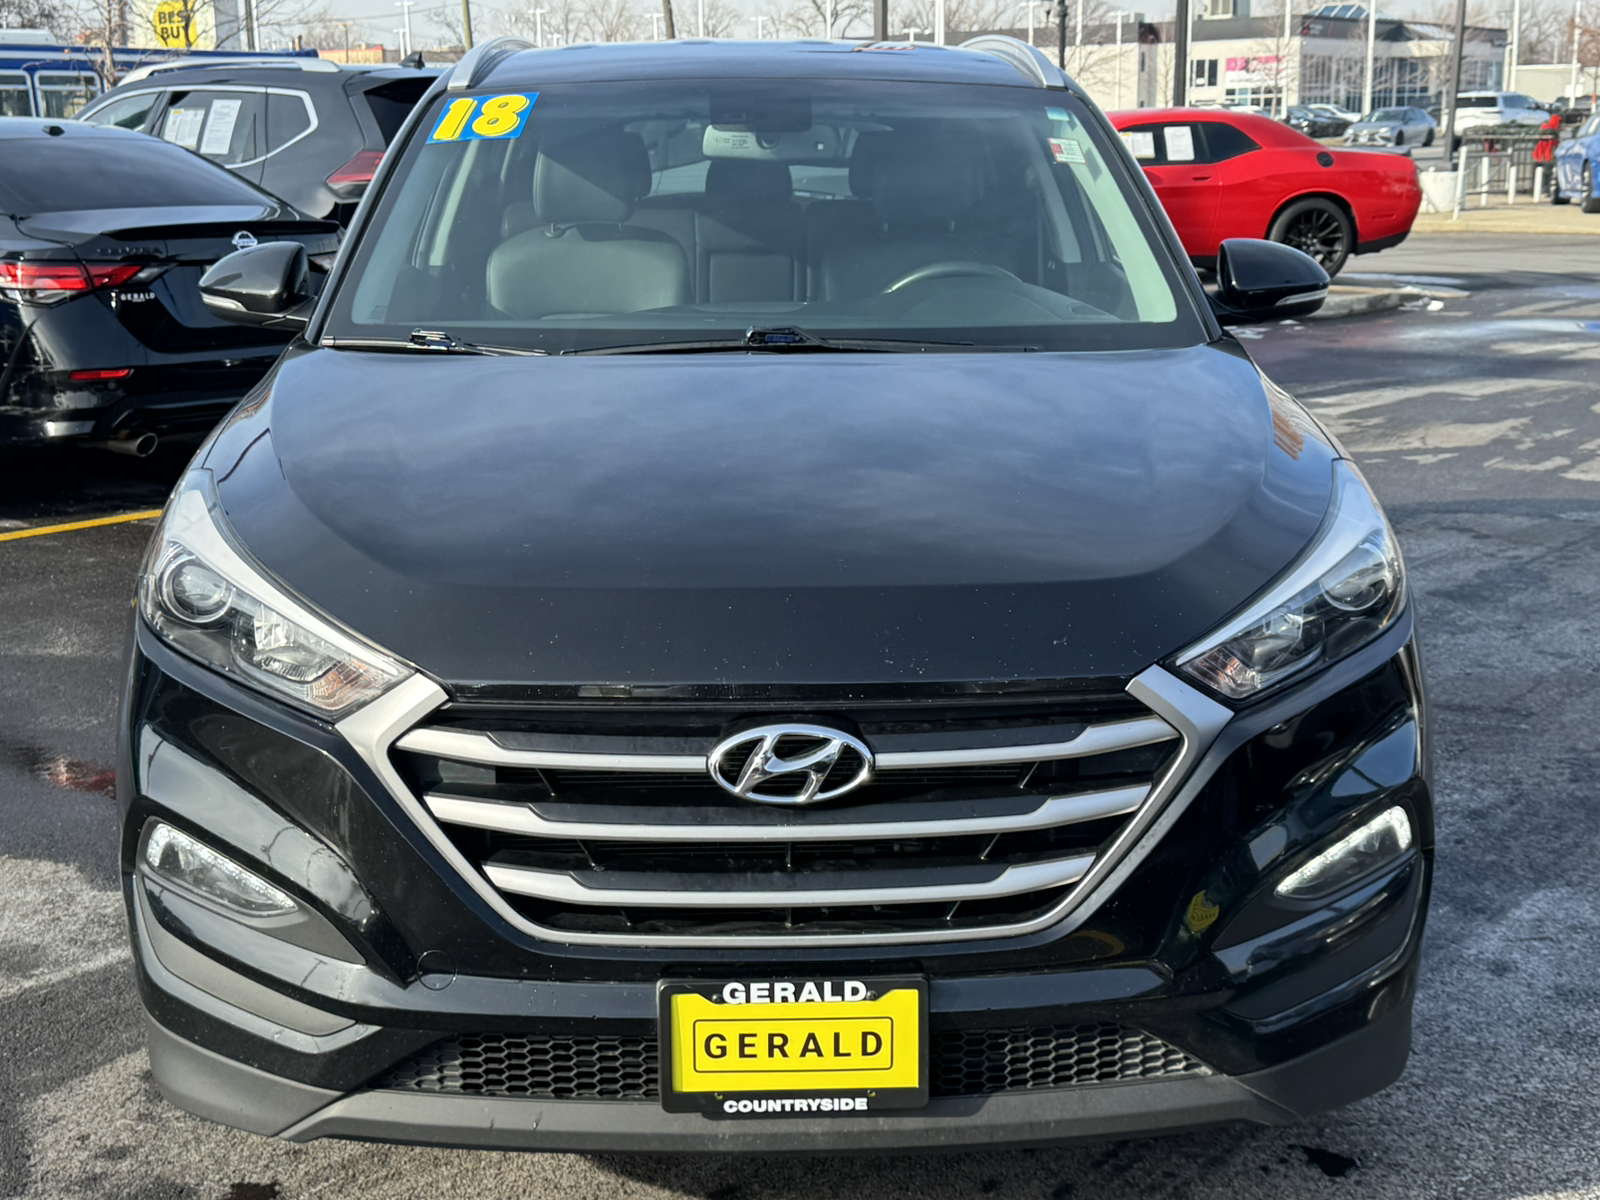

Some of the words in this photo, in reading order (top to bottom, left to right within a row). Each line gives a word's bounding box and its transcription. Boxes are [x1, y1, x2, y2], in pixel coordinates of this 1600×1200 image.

[158, 11, 191, 24] BES
[433, 95, 530, 141] 18
[120, 292, 156, 301] GERALD
[722, 981, 867, 1005] GERALD
[704, 1031, 883, 1060] GERALD
[723, 1097, 868, 1114] COUNTRYSIDE
